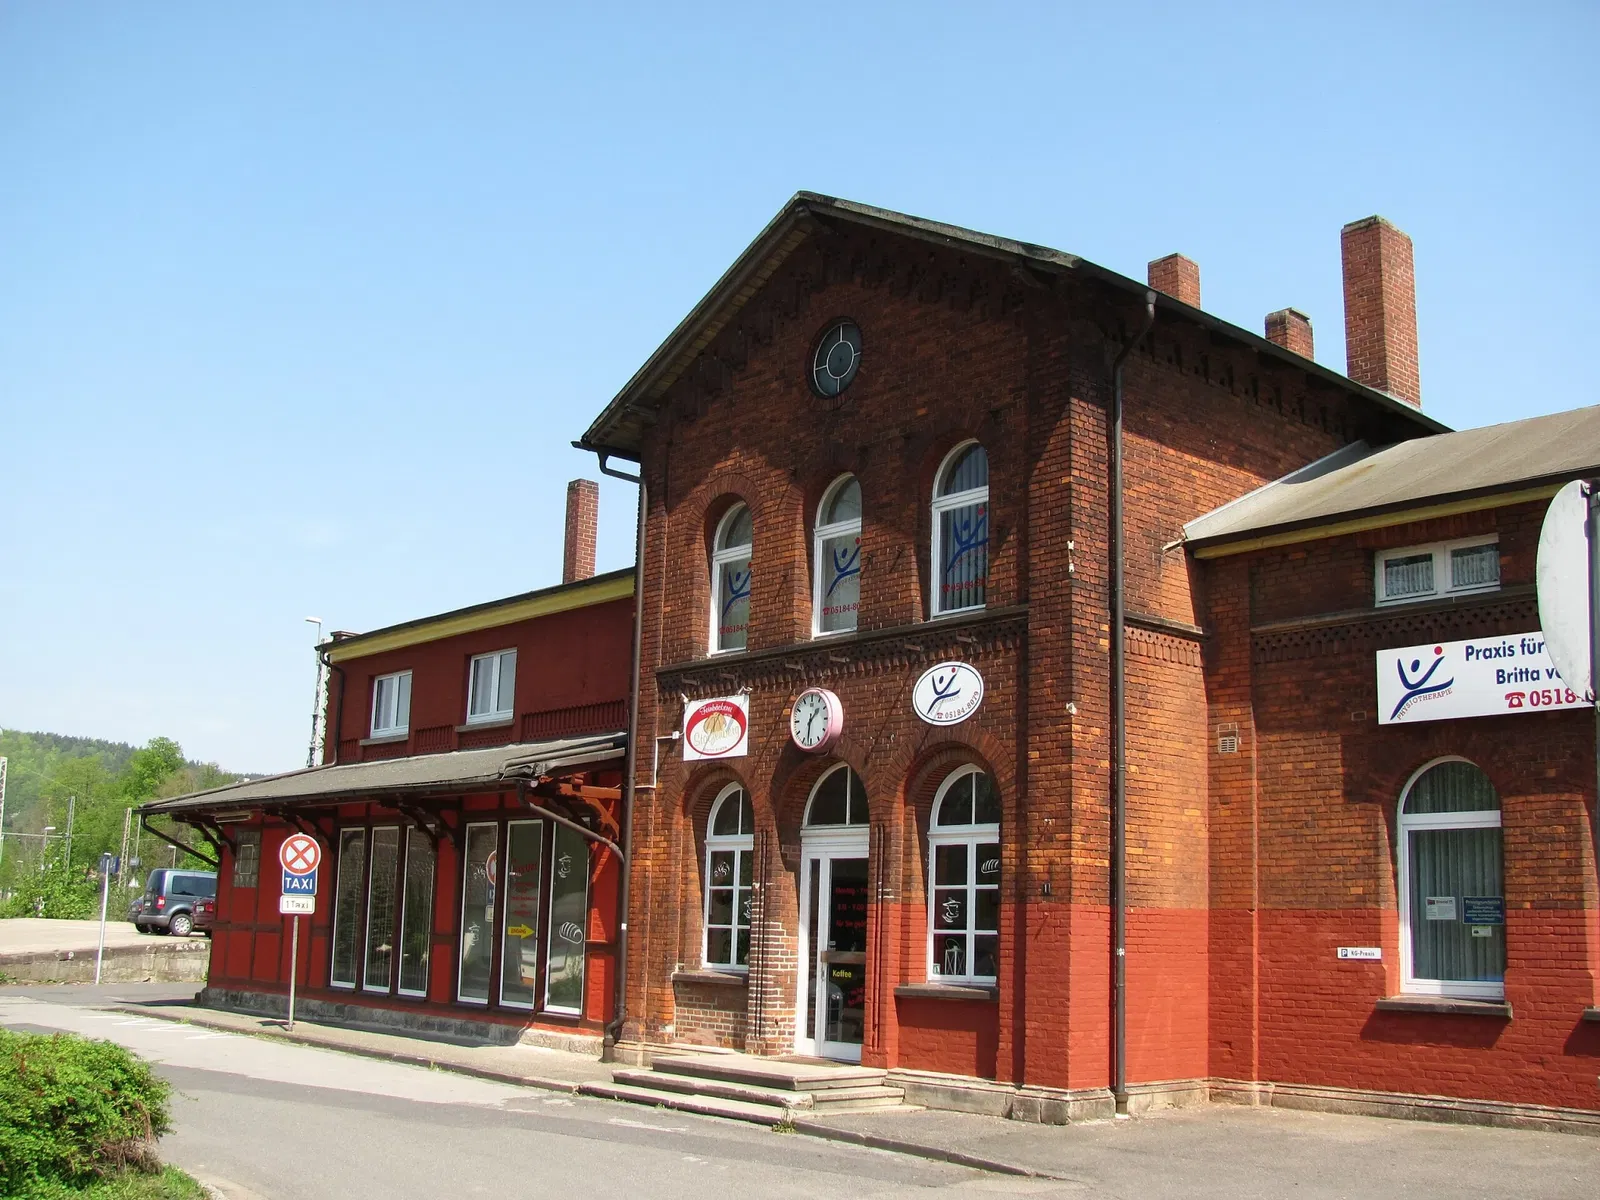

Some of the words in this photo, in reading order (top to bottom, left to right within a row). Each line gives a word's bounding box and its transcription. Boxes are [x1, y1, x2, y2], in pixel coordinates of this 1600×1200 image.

[1465, 641, 1515, 662] Praxis
[1520, 638, 1545, 656] für
[1496, 667, 1540, 685] Britta
[945, 691, 979, 719] 05184-8079
[1397, 688, 1453, 721] PHYSIOTHERAPIE
[285, 877, 313, 890] TAXI
[291, 900, 309, 909] Taxi
